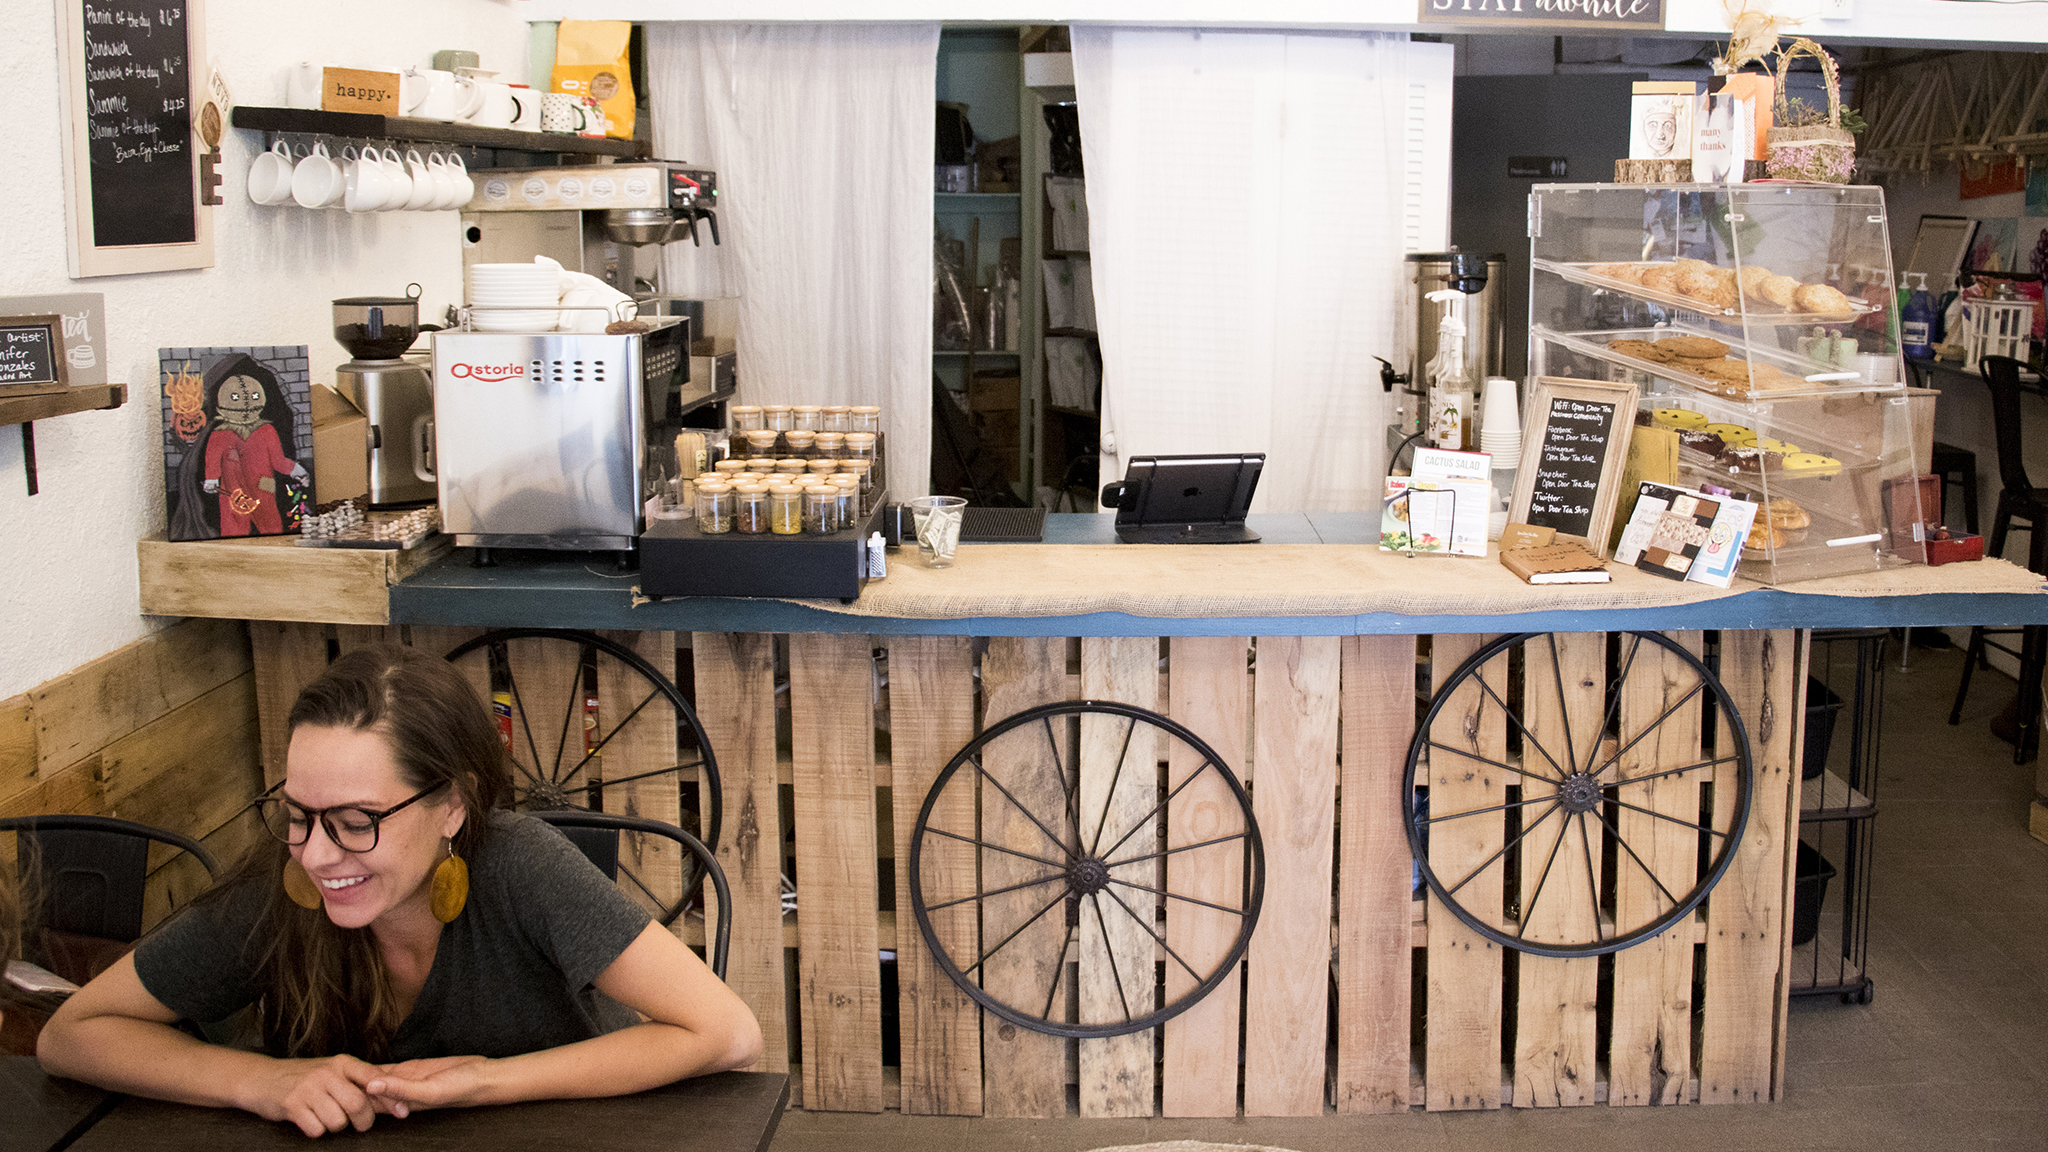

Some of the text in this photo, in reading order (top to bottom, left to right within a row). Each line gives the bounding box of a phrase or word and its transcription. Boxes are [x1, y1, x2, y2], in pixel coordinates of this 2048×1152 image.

[85, 3, 113, 25] Panini
[116, 10, 125, 25] of
[127, 11, 139, 28] the
[139, 12, 151, 37] day
[86, 30, 132, 60] Sandwich
[87, 63, 124, 82] Sandwich
[125, 62, 133, 76] of
[135, 63, 147, 79] the
[146, 64, 160, 88] day
[336, 82, 391, 102] happy.
[88, 88, 129, 116] Sammie
[121, 117, 132, 134] of
[1700, 129, 1721, 138] many
[1700, 141, 1726, 151] thanks
[450, 362, 524, 382] astoria
[1571, 402, 1585, 412] Open
[1586, 404, 1600, 412] Door
[1601, 405, 1613, 413] Tea
[1551, 433, 1564, 442] Open
[1424, 455, 1480, 471] CACTUS SALAD
[1546, 453, 1559, 461] Open
[1559, 453, 1571, 461] Door
[1541, 478, 1556, 489] Open
[1557, 480, 1570, 488] Door
[1531, 503, 1589, 516] Open Door Tea Shop
